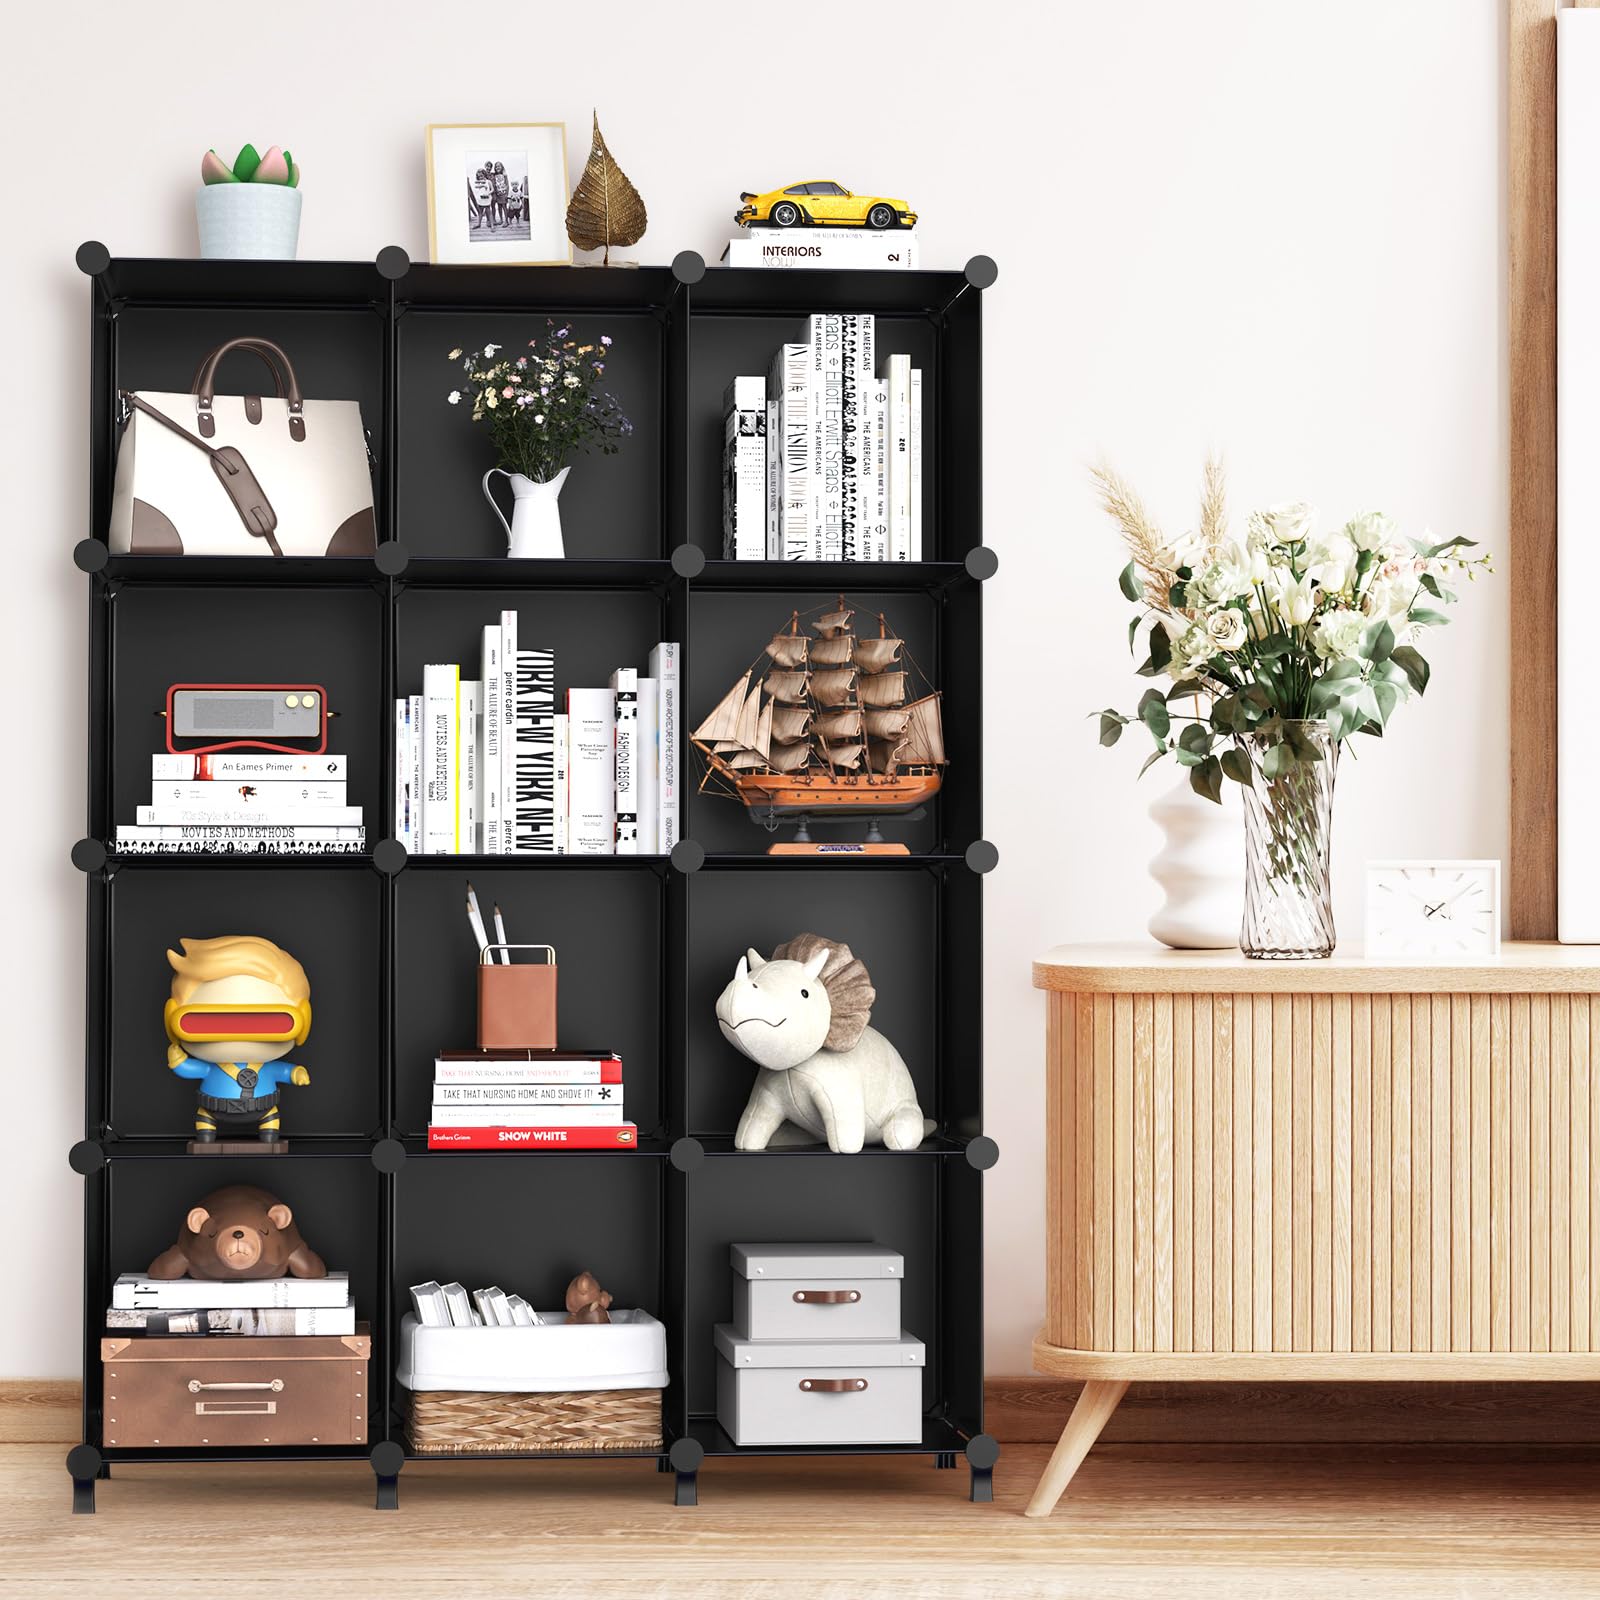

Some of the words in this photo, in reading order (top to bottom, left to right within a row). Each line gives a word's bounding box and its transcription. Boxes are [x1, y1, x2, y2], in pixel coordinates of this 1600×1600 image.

[762, 246, 822, 257] INTERIORS
[888, 254, 900, 262] 2
[826, 372, 842, 404] Elliott
[788, 424, 808, 474] FASHION
[488, 678, 497, 691] THE
[504, 672, 514, 696] pierre
[488, 692, 497, 718] ALLURE
[504, 698, 514, 725] cardin
[436, 714, 448, 746] MOVIES
[488, 719, 497, 729] OF
[488, 729, 497, 756] BEAUTY
[618, 732, 630, 763] FASHION
[222, 763, 233, 771] An
[236, 763, 263, 771] Eames
[266, 763, 293, 771] Primer
[436, 747, 448, 764] AND
[436, 764, 448, 802] METHODS
[516, 752, 554, 802] YORK
[618, 766, 630, 793] DESIGN
[181, 828, 223, 838] MOVIES
[224, 828, 246, 838] AND
[247, 828, 295, 838] METHODS
[488, 820, 497, 834] THE
[504, 820, 514, 845] pierre
[444, 1089, 460, 1099] TAKE
[463, 1089, 481, 1099] THAT
[484, 1089, 516, 1099] NURSING
[518, 1089, 538, 1099] HOME
[541, 1089, 556, 1099] AND
[558, 1089, 582, 1099] SHOVE
[584, 1089, 593, 1099] IT!
[498, 1132, 532, 1142] SNOW
[533, 1132, 567, 1142] WHITE
